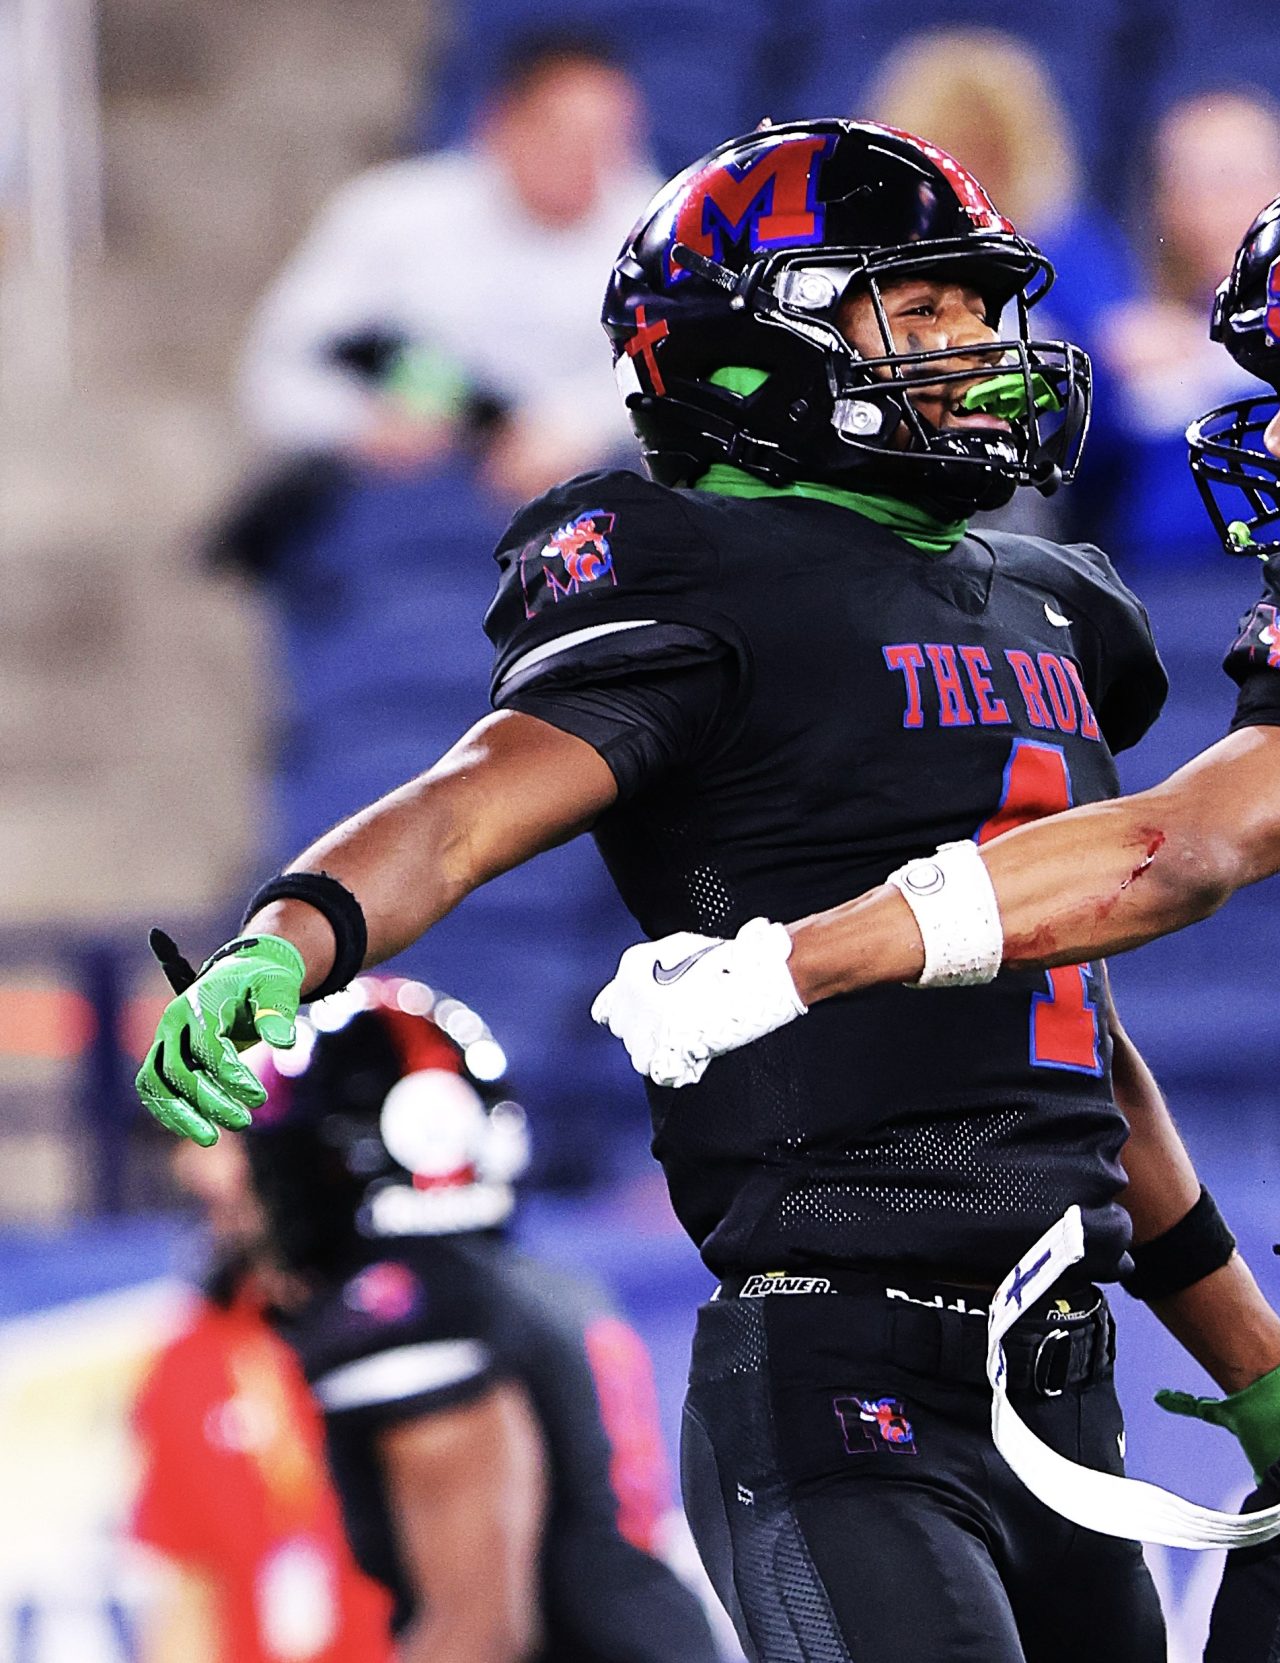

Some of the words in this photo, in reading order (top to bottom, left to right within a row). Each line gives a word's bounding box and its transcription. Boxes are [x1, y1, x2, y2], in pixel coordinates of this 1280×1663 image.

[664, 133, 840, 288] M
[882, 642, 1012, 729] THE
[739, 1274, 831, 1298] POWER
